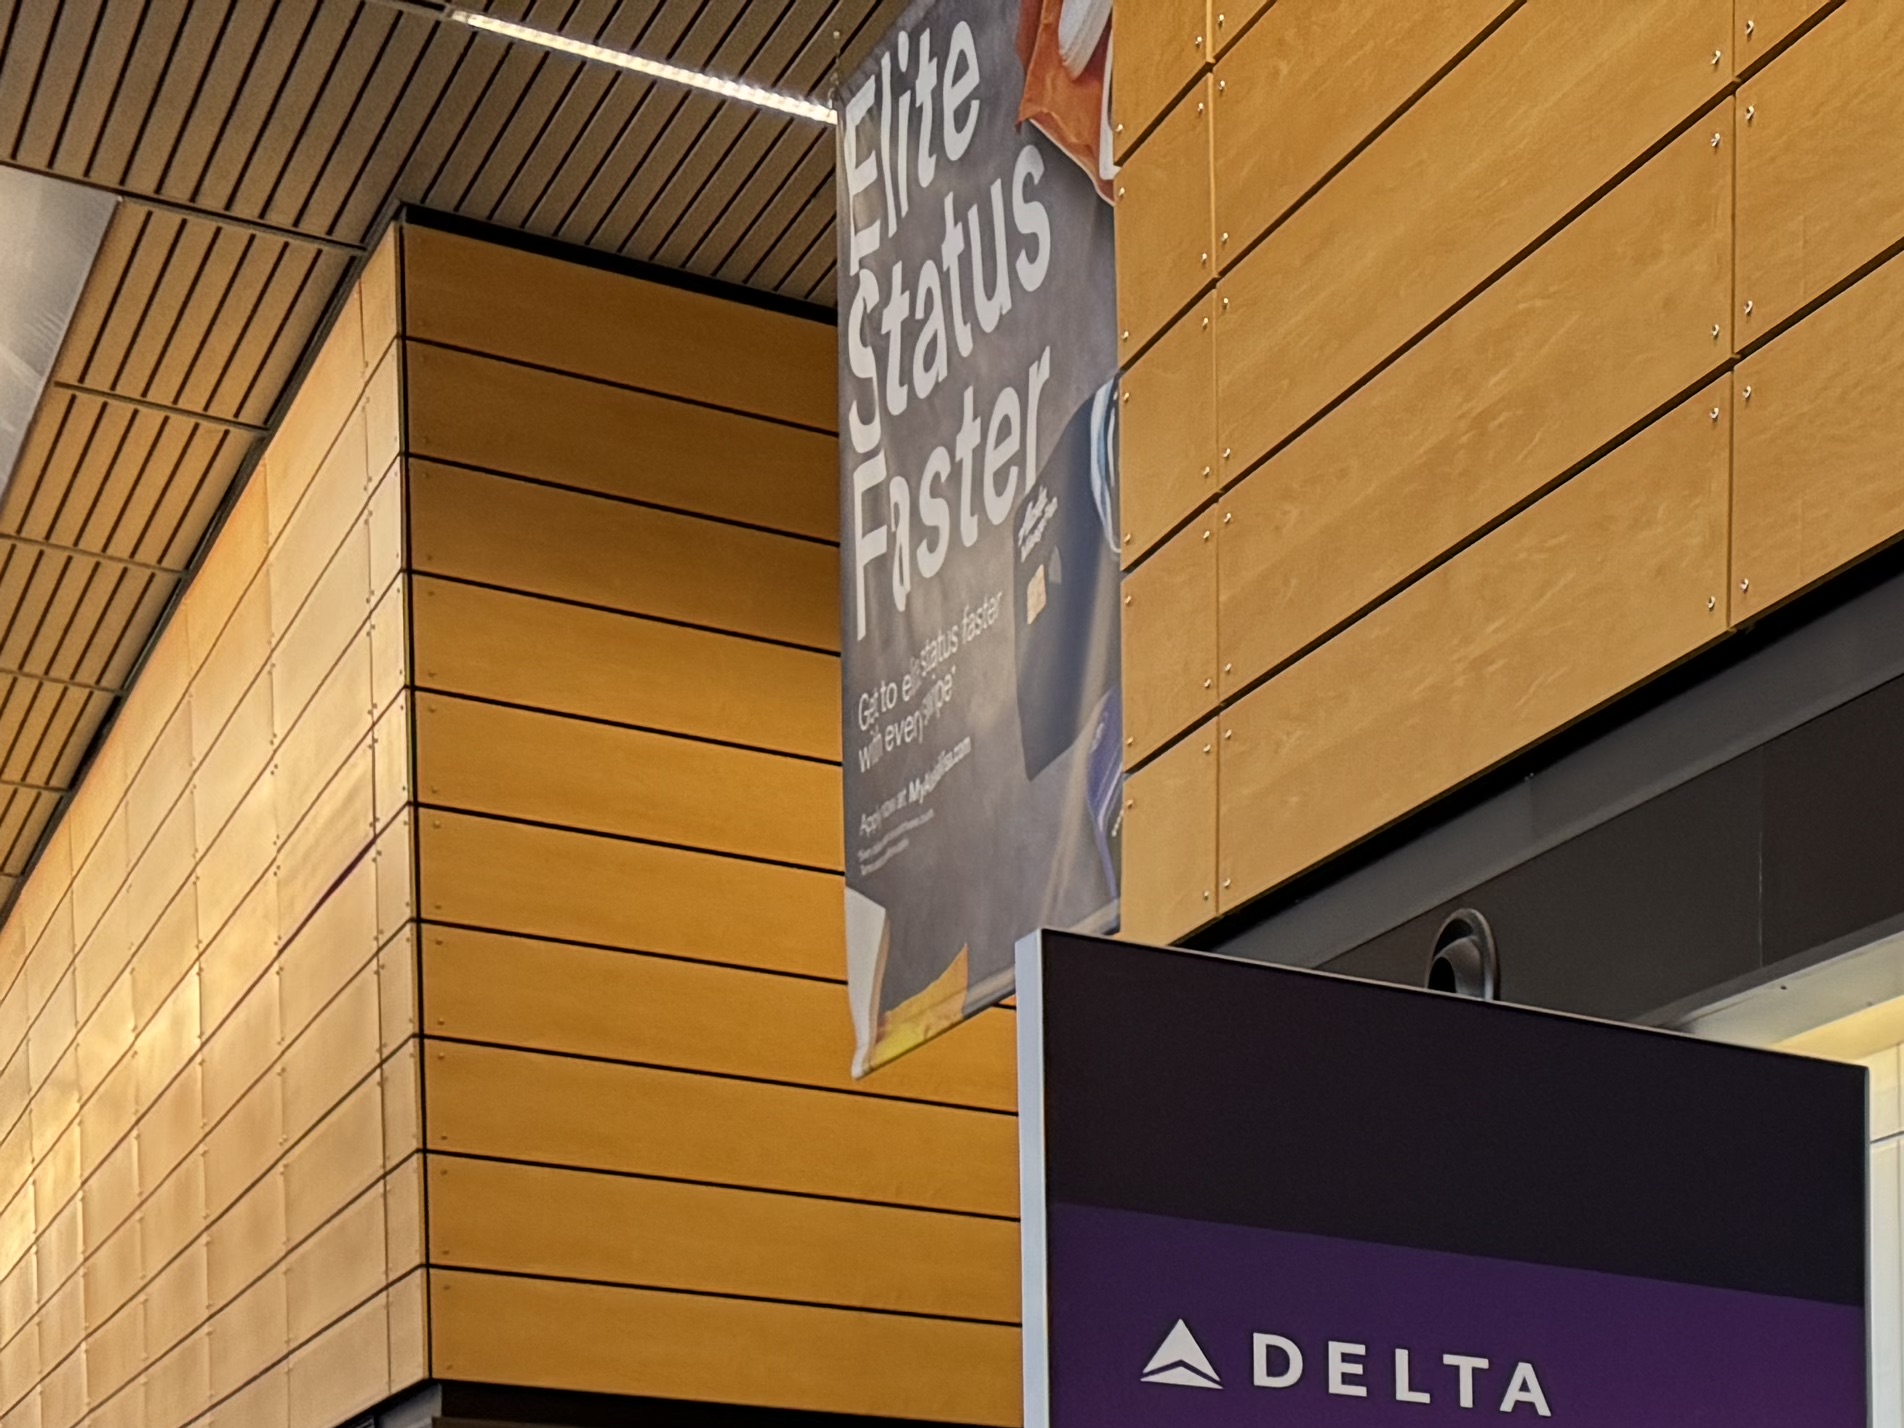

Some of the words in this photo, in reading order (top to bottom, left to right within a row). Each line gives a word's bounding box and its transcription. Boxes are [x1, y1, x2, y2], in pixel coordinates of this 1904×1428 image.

[844, 20, 980, 276] Elite
[848, 144, 1051, 454] Status
[852, 345, 1050, 641] Faster
[879, 680, 898, 713] to
[1252, 1332, 1552, 1417] DELTA
